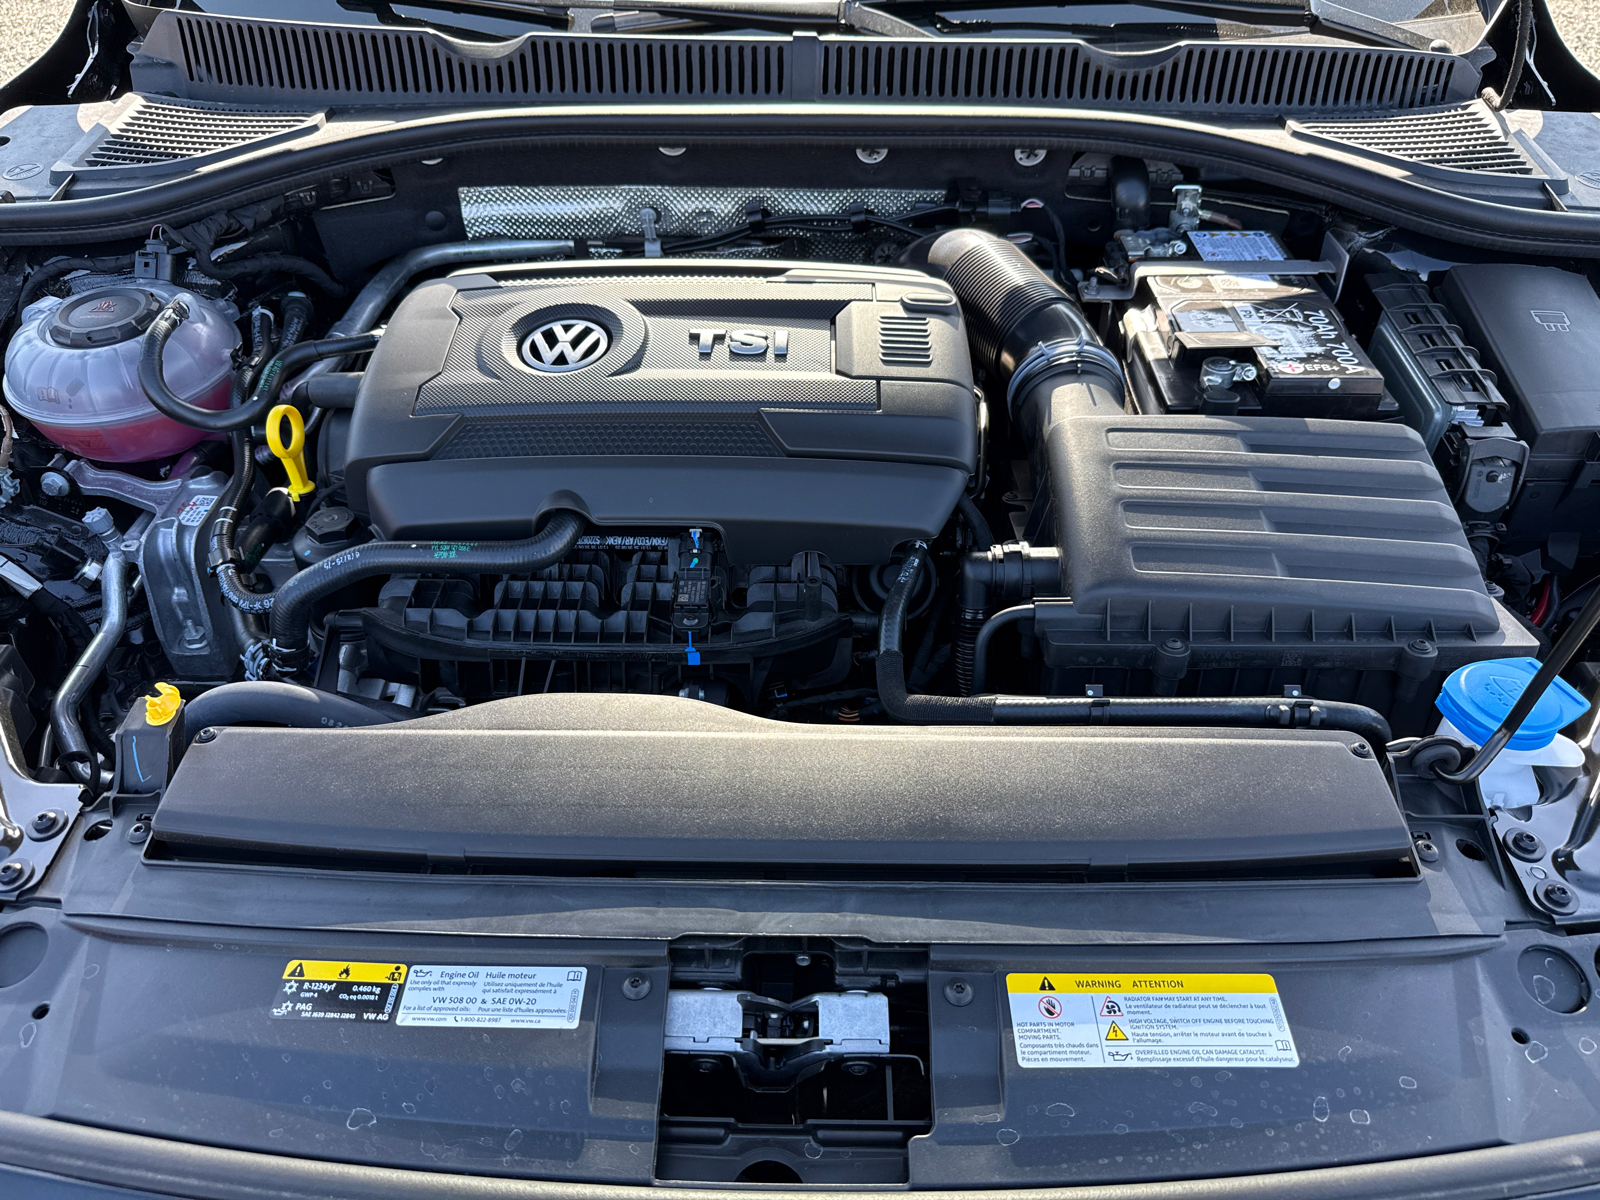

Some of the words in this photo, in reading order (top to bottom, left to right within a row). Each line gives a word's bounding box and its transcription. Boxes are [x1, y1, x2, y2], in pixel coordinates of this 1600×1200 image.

[1243, 310, 1252, 319] Pb
[525, 321, 605, 369] VW
[688, 329, 790, 357] TSI
[1303, 310, 1338, 339] 70Ah
[1327, 342, 1365, 374] 700A
[1305, 363, 1340, 371] EFB+
[440, 971, 466, 980] Engine
[303, 982, 337, 992] R-1234yf
[372, 986, 381, 994] kg
[1075, 980, 1121, 988] WARNING
[1132, 980, 1184, 988] ATTENTION
[295, 1003, 313, 1011] PAG
